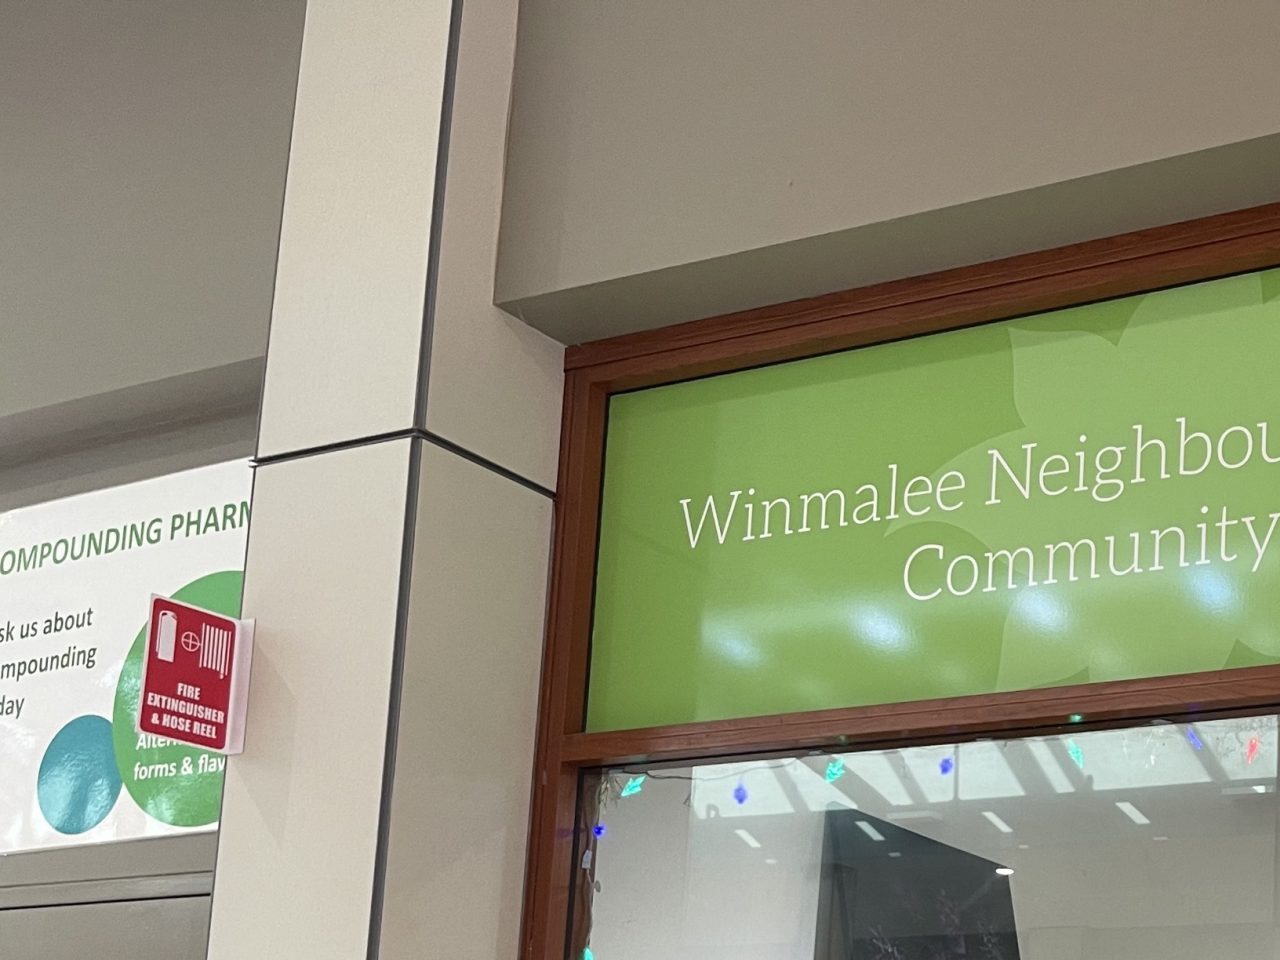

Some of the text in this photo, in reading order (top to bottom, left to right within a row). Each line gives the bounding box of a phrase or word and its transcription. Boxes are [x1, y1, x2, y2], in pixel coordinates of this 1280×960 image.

[680, 465, 966, 549] Winmalee
[0, 518, 163, 575] OMPOUNDING
[20, 621, 38, 639] us
[43, 608, 93, 635] about
[1, 646, 97, 682] mpounding
[177, 683, 201, 700] FIRE
[147, 692, 225, 724] EXTINGUISHER
[151, 713, 217, 739] & HOSE REEL
[134, 762, 176, 781] forms
[181, 757, 193, 775] &
